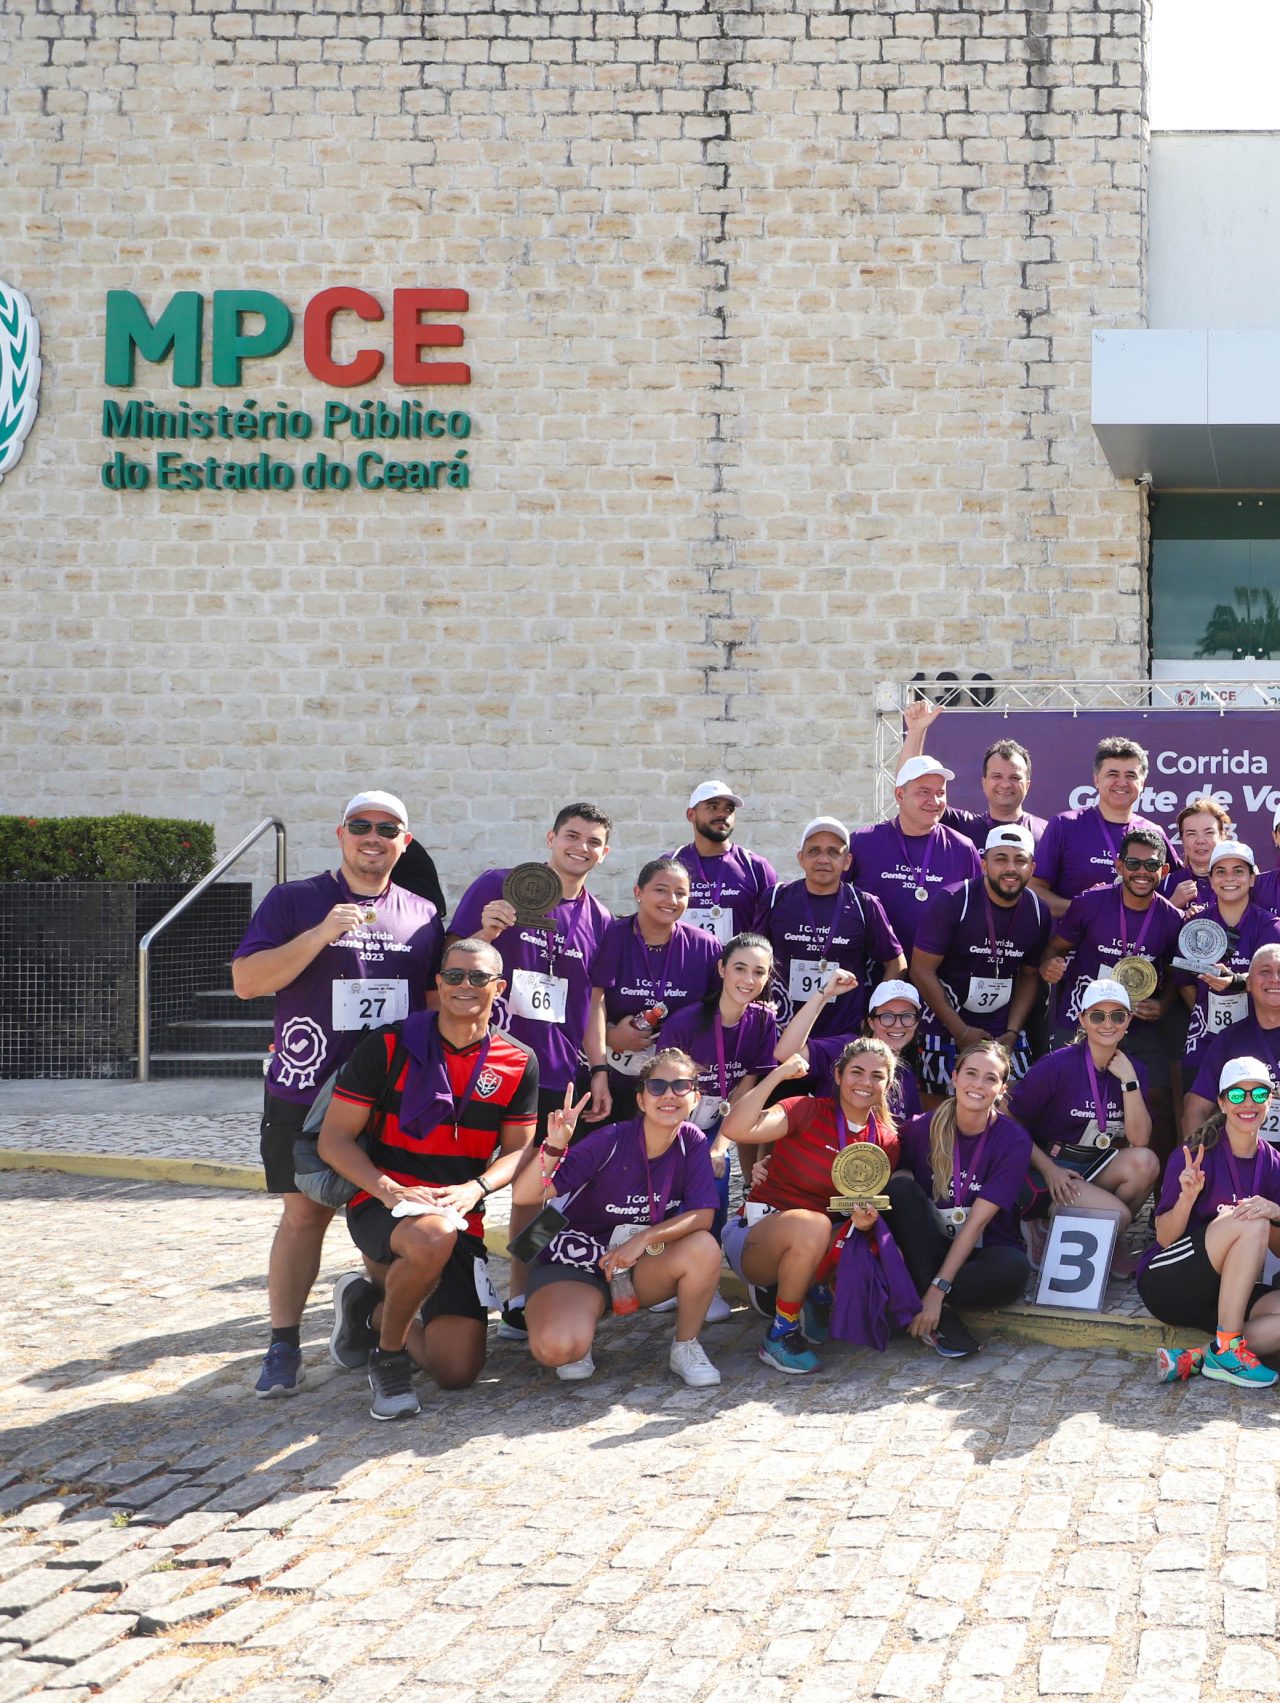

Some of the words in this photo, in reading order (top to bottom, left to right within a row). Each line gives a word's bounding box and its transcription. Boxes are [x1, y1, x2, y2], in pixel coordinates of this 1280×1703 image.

[105, 286, 471, 388] MPCE
[102, 399, 313, 441] Ministério
[324, 399, 471, 441] Público
[101, 450, 150, 490] do
[157, 450, 294, 490] Estado
[302, 450, 351, 490] do
[357, 449, 470, 490] Ceará
[1156, 748, 1268, 774] Corrida
[1068, 786, 1178, 812] Gte
[1186, 784, 1232, 812] de
[1168, 823, 1239, 845] 23
[1090, 857, 1114, 866] Gente
[881, 872, 907, 880] Gente
[355, 930, 394, 941] Corrida
[785, 933, 812, 942] Gente
[829, 937, 850, 945] alor
[366, 941, 381, 950] de
[383, 941, 412, 953] Valor
[970, 945, 992, 954] Gente
[1004, 949, 1025, 958] Valor
[1097, 944, 1123, 956] Gente
[1117, 939, 1146, 952] Crria
[360, 951, 385, 961] 2023
[802, 976, 822, 993] 91
[620, 987, 650, 996] Gente
[664, 989, 688, 998] Valor
[532, 991, 551, 1010] 66
[978, 993, 999, 1006] 37
[362, 998, 389, 1018] 27
[1215, 1010, 1232, 1025] 58
[713, 1062, 742, 1071] Crida
[1070, 1109, 1096, 1118] Gente
[605, 1204, 639, 1215] Gente
[1048, 1230, 1098, 1293] 3
